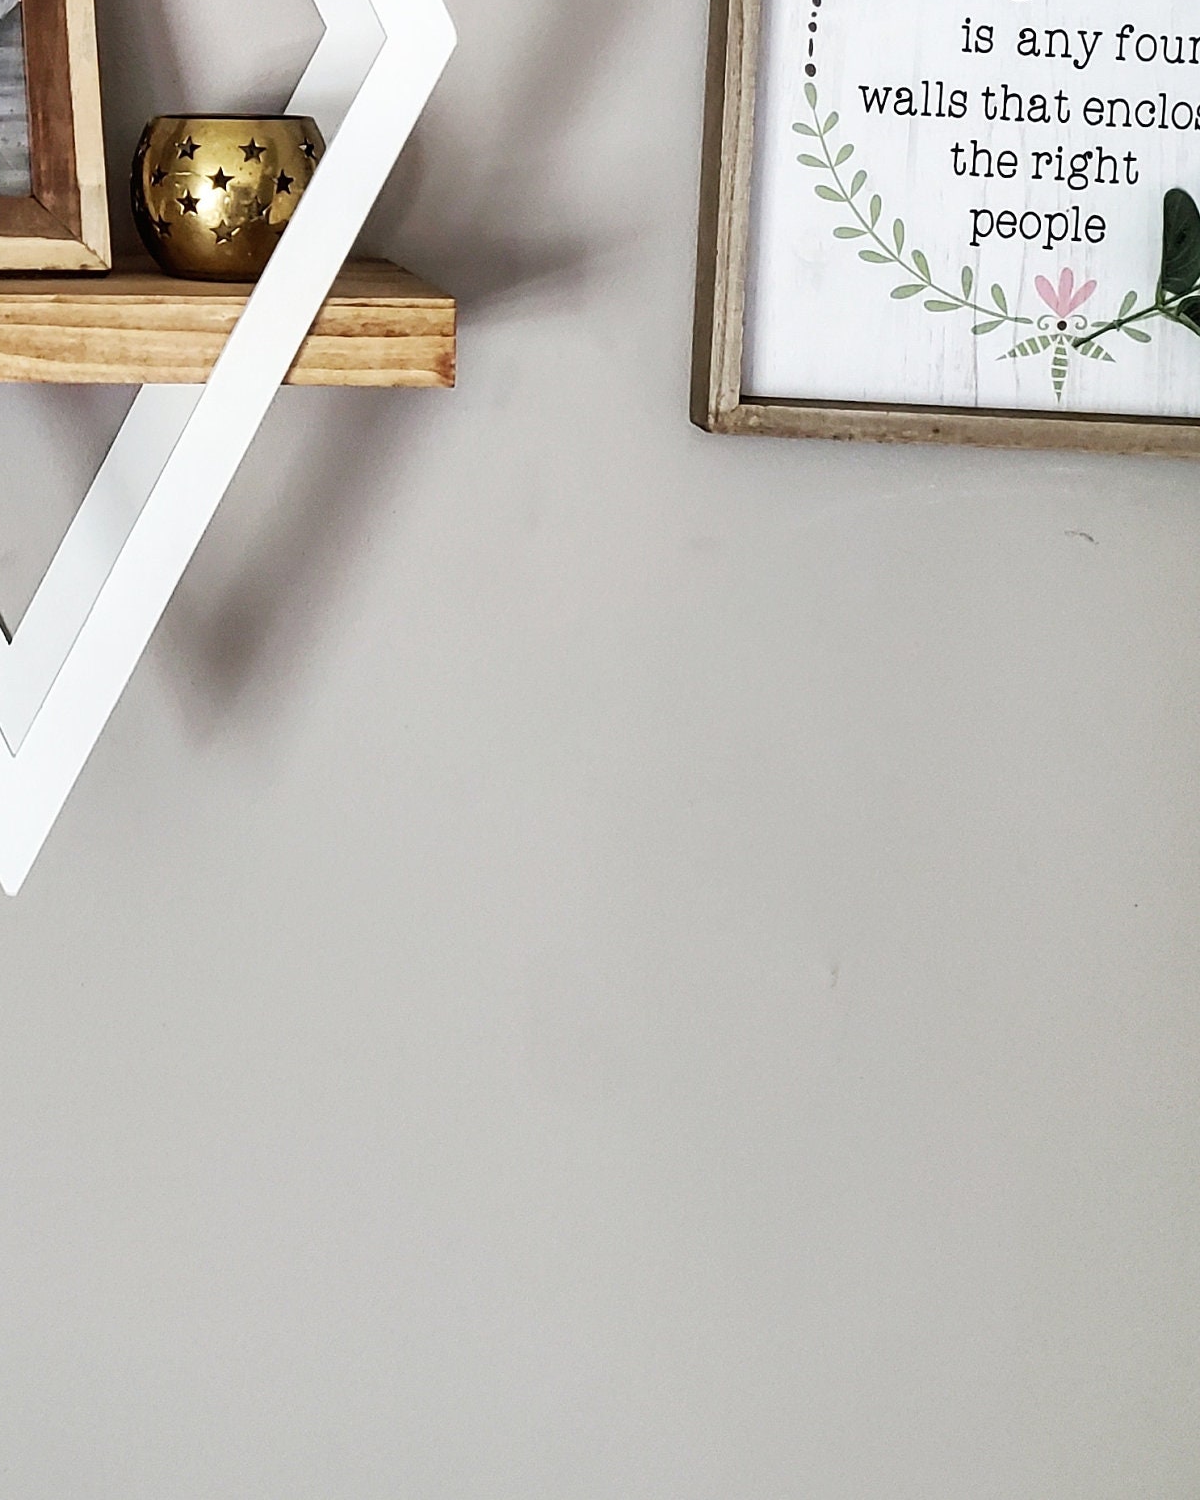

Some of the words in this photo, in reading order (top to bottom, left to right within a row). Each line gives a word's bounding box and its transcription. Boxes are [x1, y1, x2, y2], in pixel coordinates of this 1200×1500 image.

[962, 18, 993, 53] is
[1016, 28, 1102, 69] any
[858, 80, 968, 119] walls
[981, 84, 1071, 124] that
[1082, 93, 1200, 130] enclo
[950, 139, 1018, 179] the
[1031, 145, 1139, 190] right
[970, 206, 1106, 250] people
